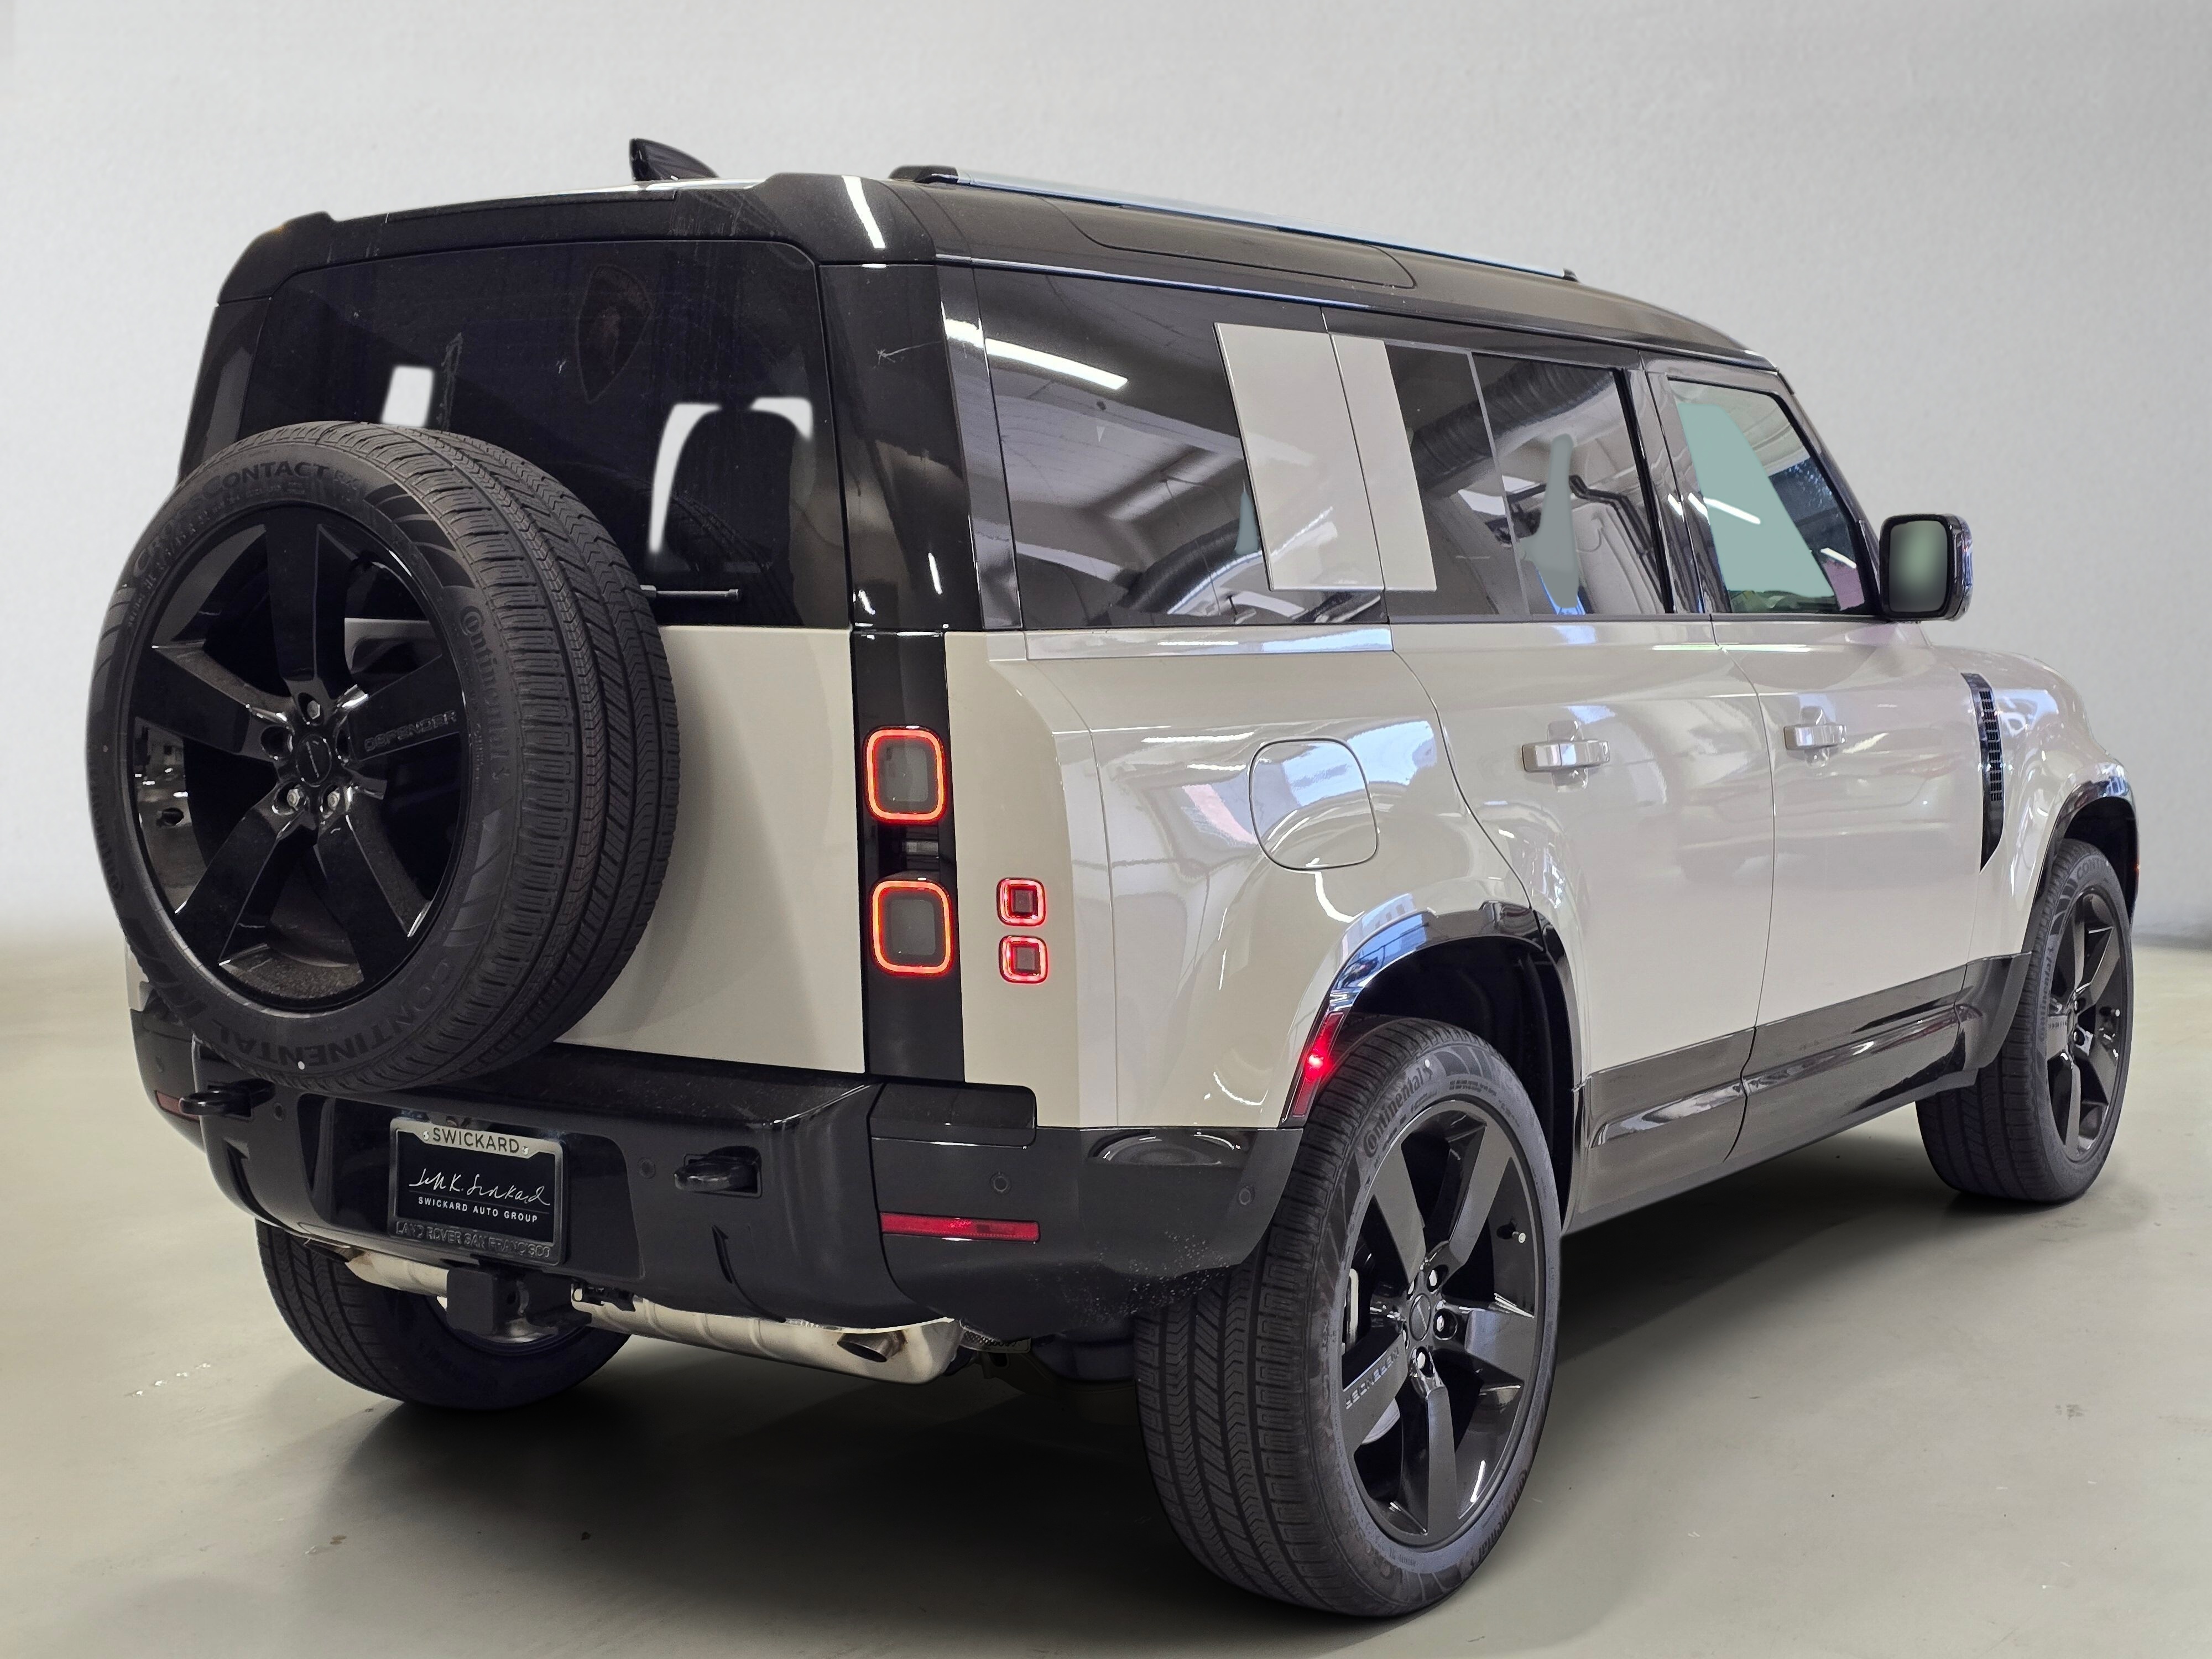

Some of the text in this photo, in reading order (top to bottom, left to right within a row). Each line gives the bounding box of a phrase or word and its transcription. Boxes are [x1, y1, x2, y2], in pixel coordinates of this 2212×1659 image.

[364, 710, 456, 752] DEFENDER
[1363, 1067, 1425, 1158] Continental
[432, 1127, 519, 1154] SWICKARD
[418, 1196, 538, 1223] SWICKARD AUTO GROUP
[395, 1220, 551, 1259] LAND ROVER SAN FRANCISCO
